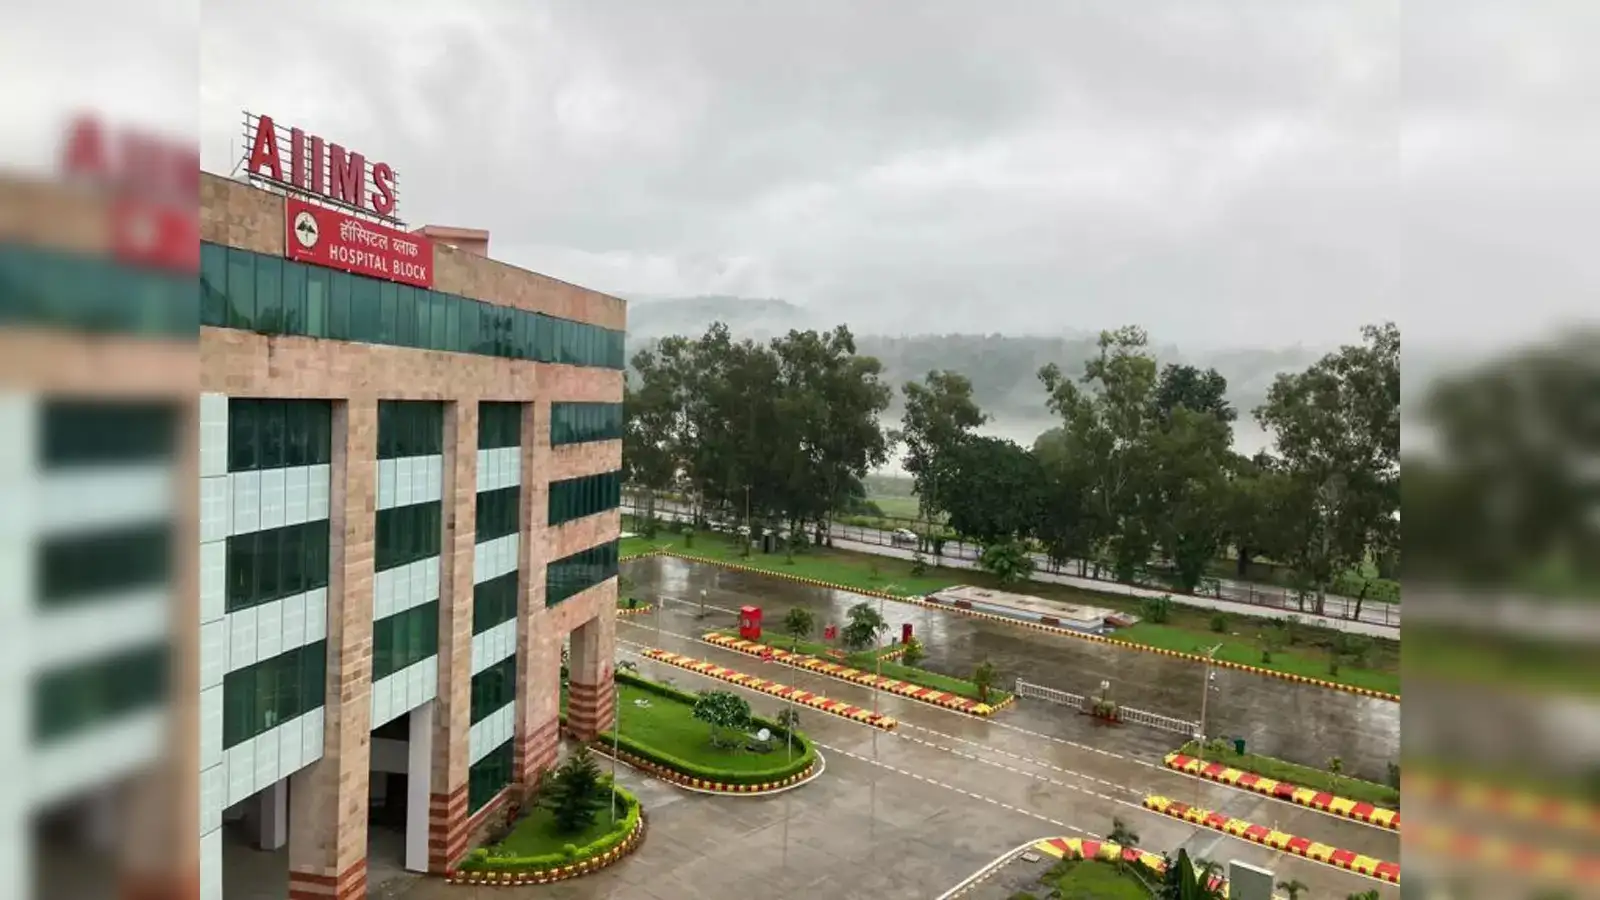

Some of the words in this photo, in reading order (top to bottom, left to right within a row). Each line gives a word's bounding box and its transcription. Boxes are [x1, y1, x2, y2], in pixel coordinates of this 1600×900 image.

[249, 114, 394, 215] AIIMS
[339, 219, 388, 250] हॉस्पिटल
[392, 238, 418, 257] ब्लाक
[329, 244, 388, 272] HOSPITAL
[393, 260, 426, 280] BLOCK
